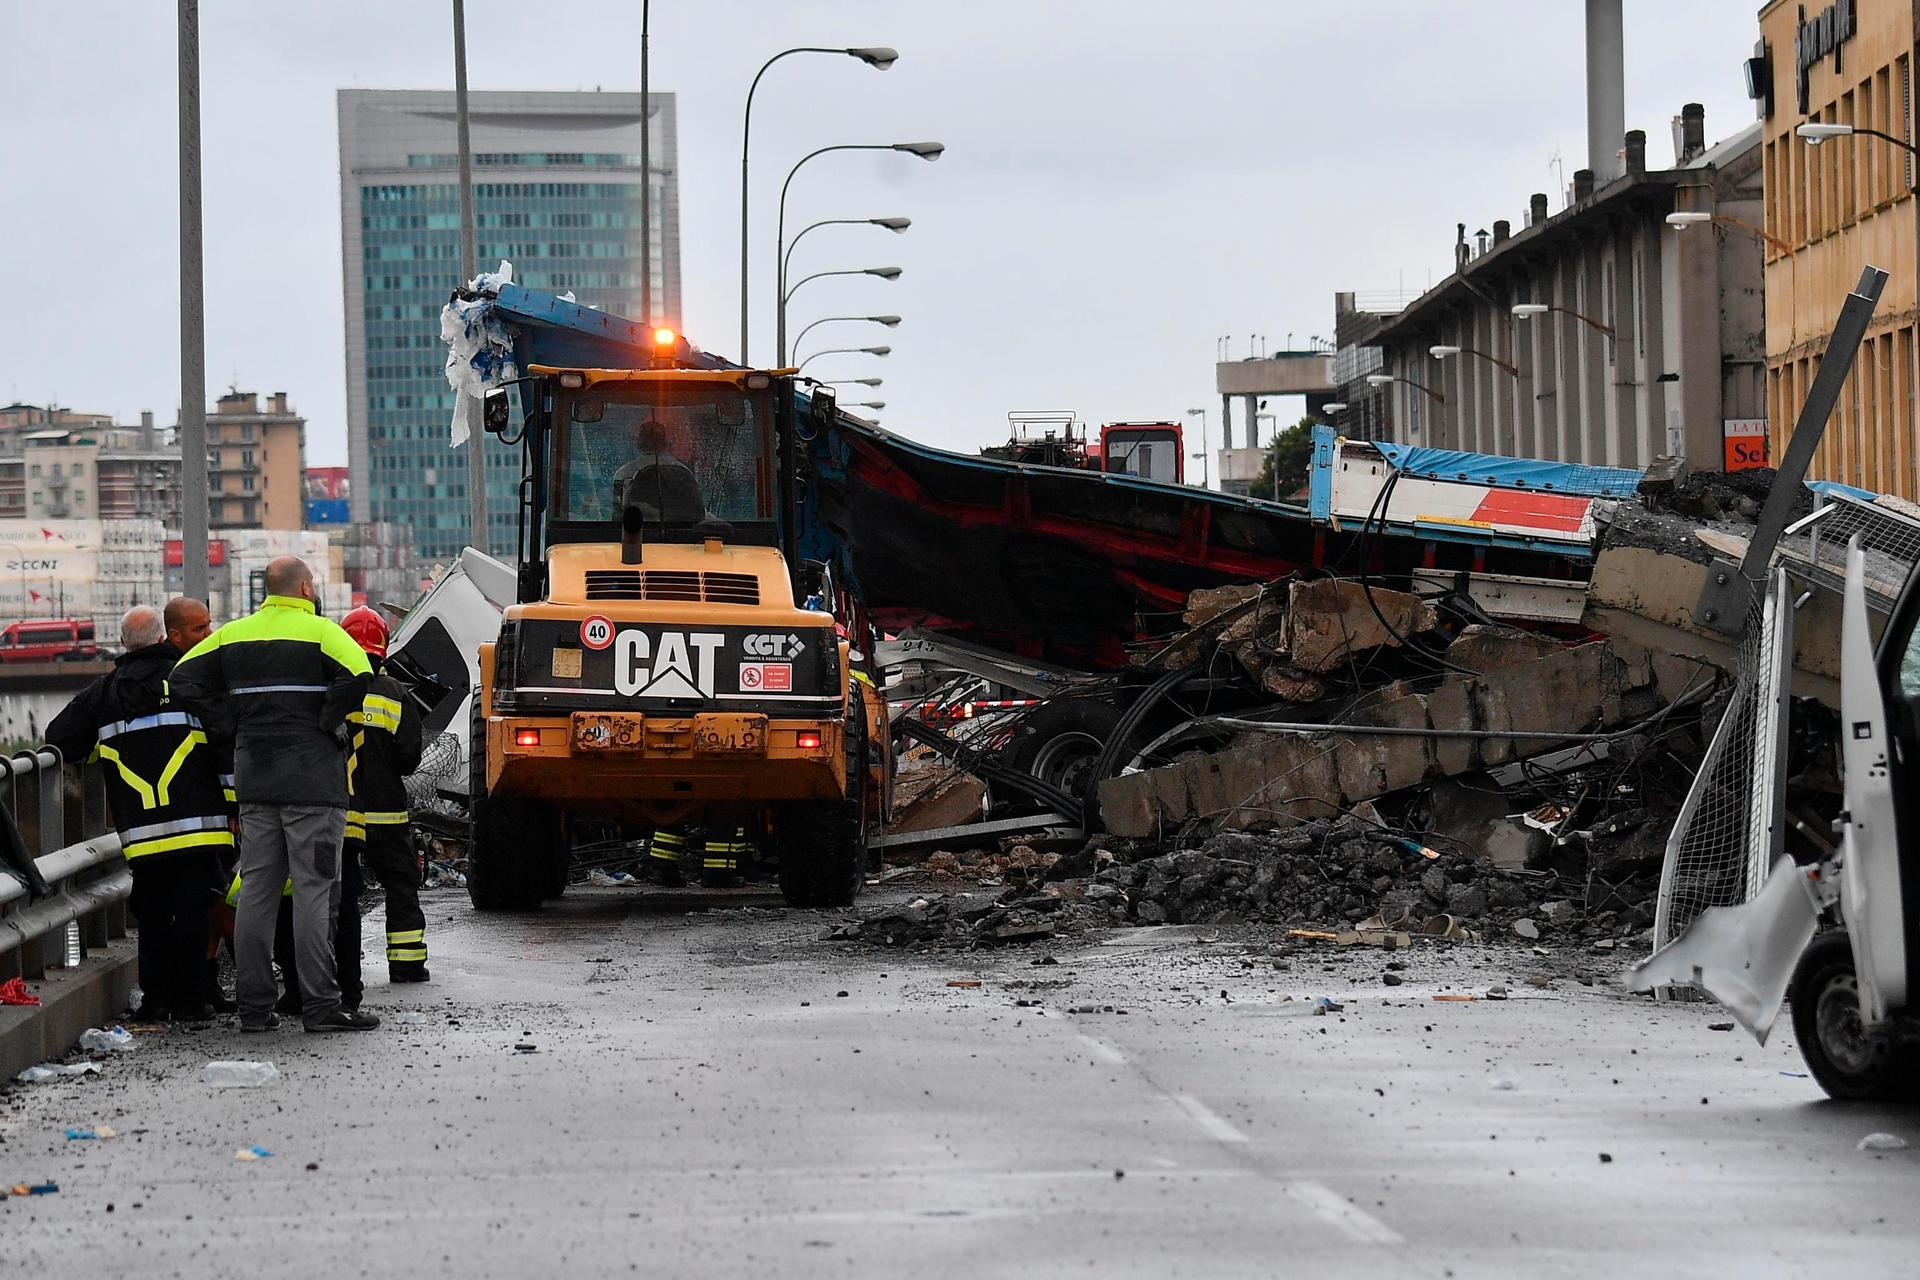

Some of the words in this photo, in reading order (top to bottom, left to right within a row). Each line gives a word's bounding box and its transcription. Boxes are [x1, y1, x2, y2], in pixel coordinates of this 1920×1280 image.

[22, 560, 57, 570] CCNI
[589, 625, 606, 639] 40
[743, 634, 786, 656] CGT
[615, 629, 725, 699] CAT
